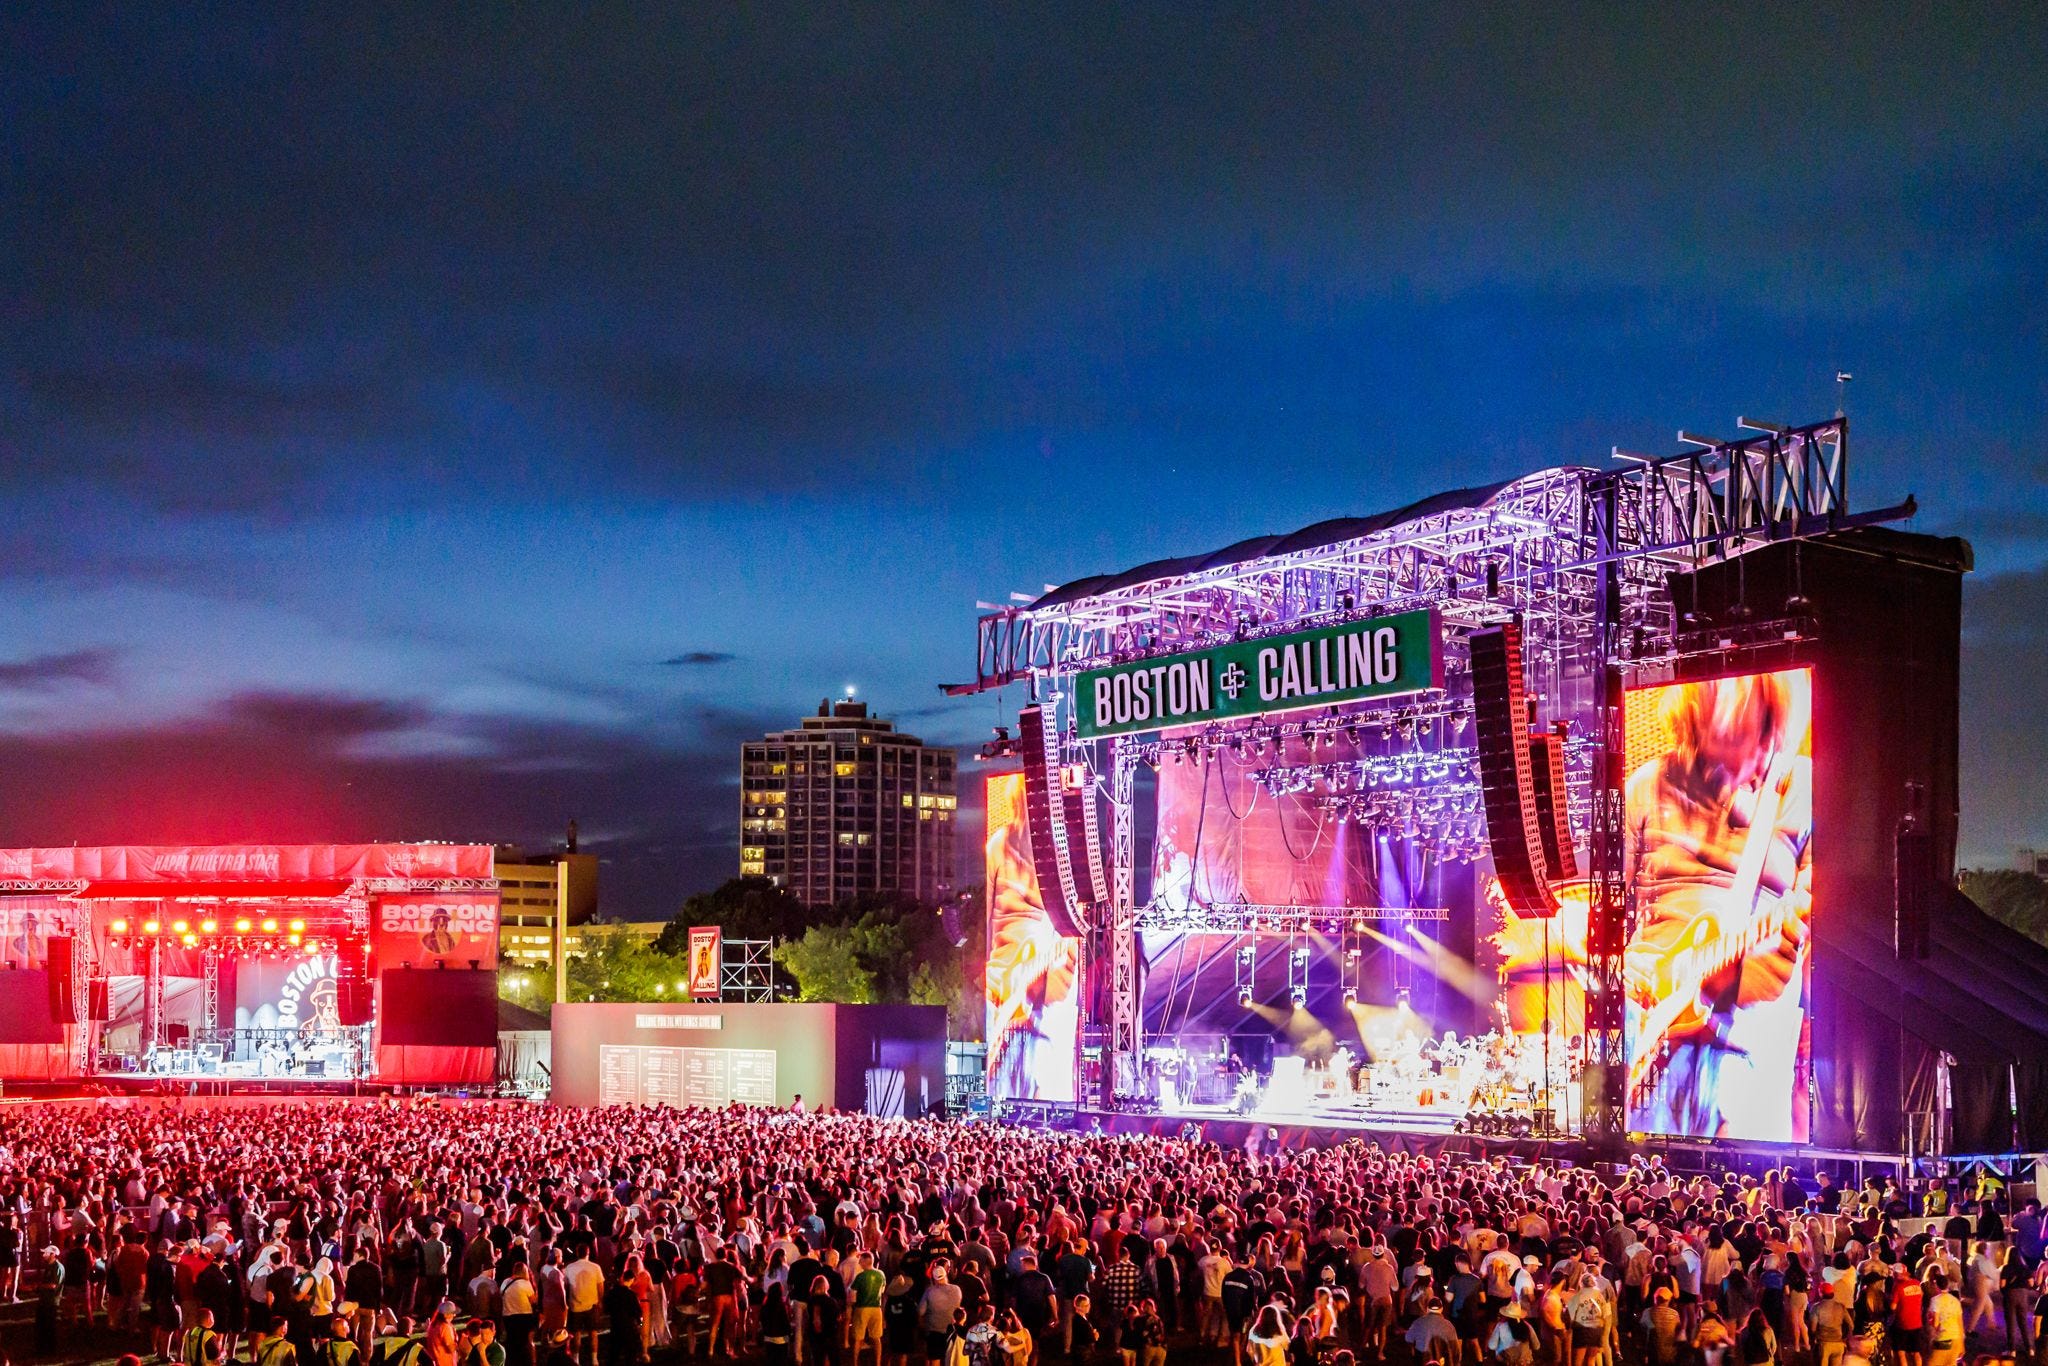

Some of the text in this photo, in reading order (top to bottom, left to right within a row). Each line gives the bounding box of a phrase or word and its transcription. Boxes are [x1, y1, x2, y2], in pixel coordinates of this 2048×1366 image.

[1095, 627, 1398, 727] BOSTON CALLING
[153, 854, 280, 871] HAPPY VALLEY RED STAGE
[382, 904, 496, 920] BOSTON
[278, 954, 325, 1028] BOSTON
